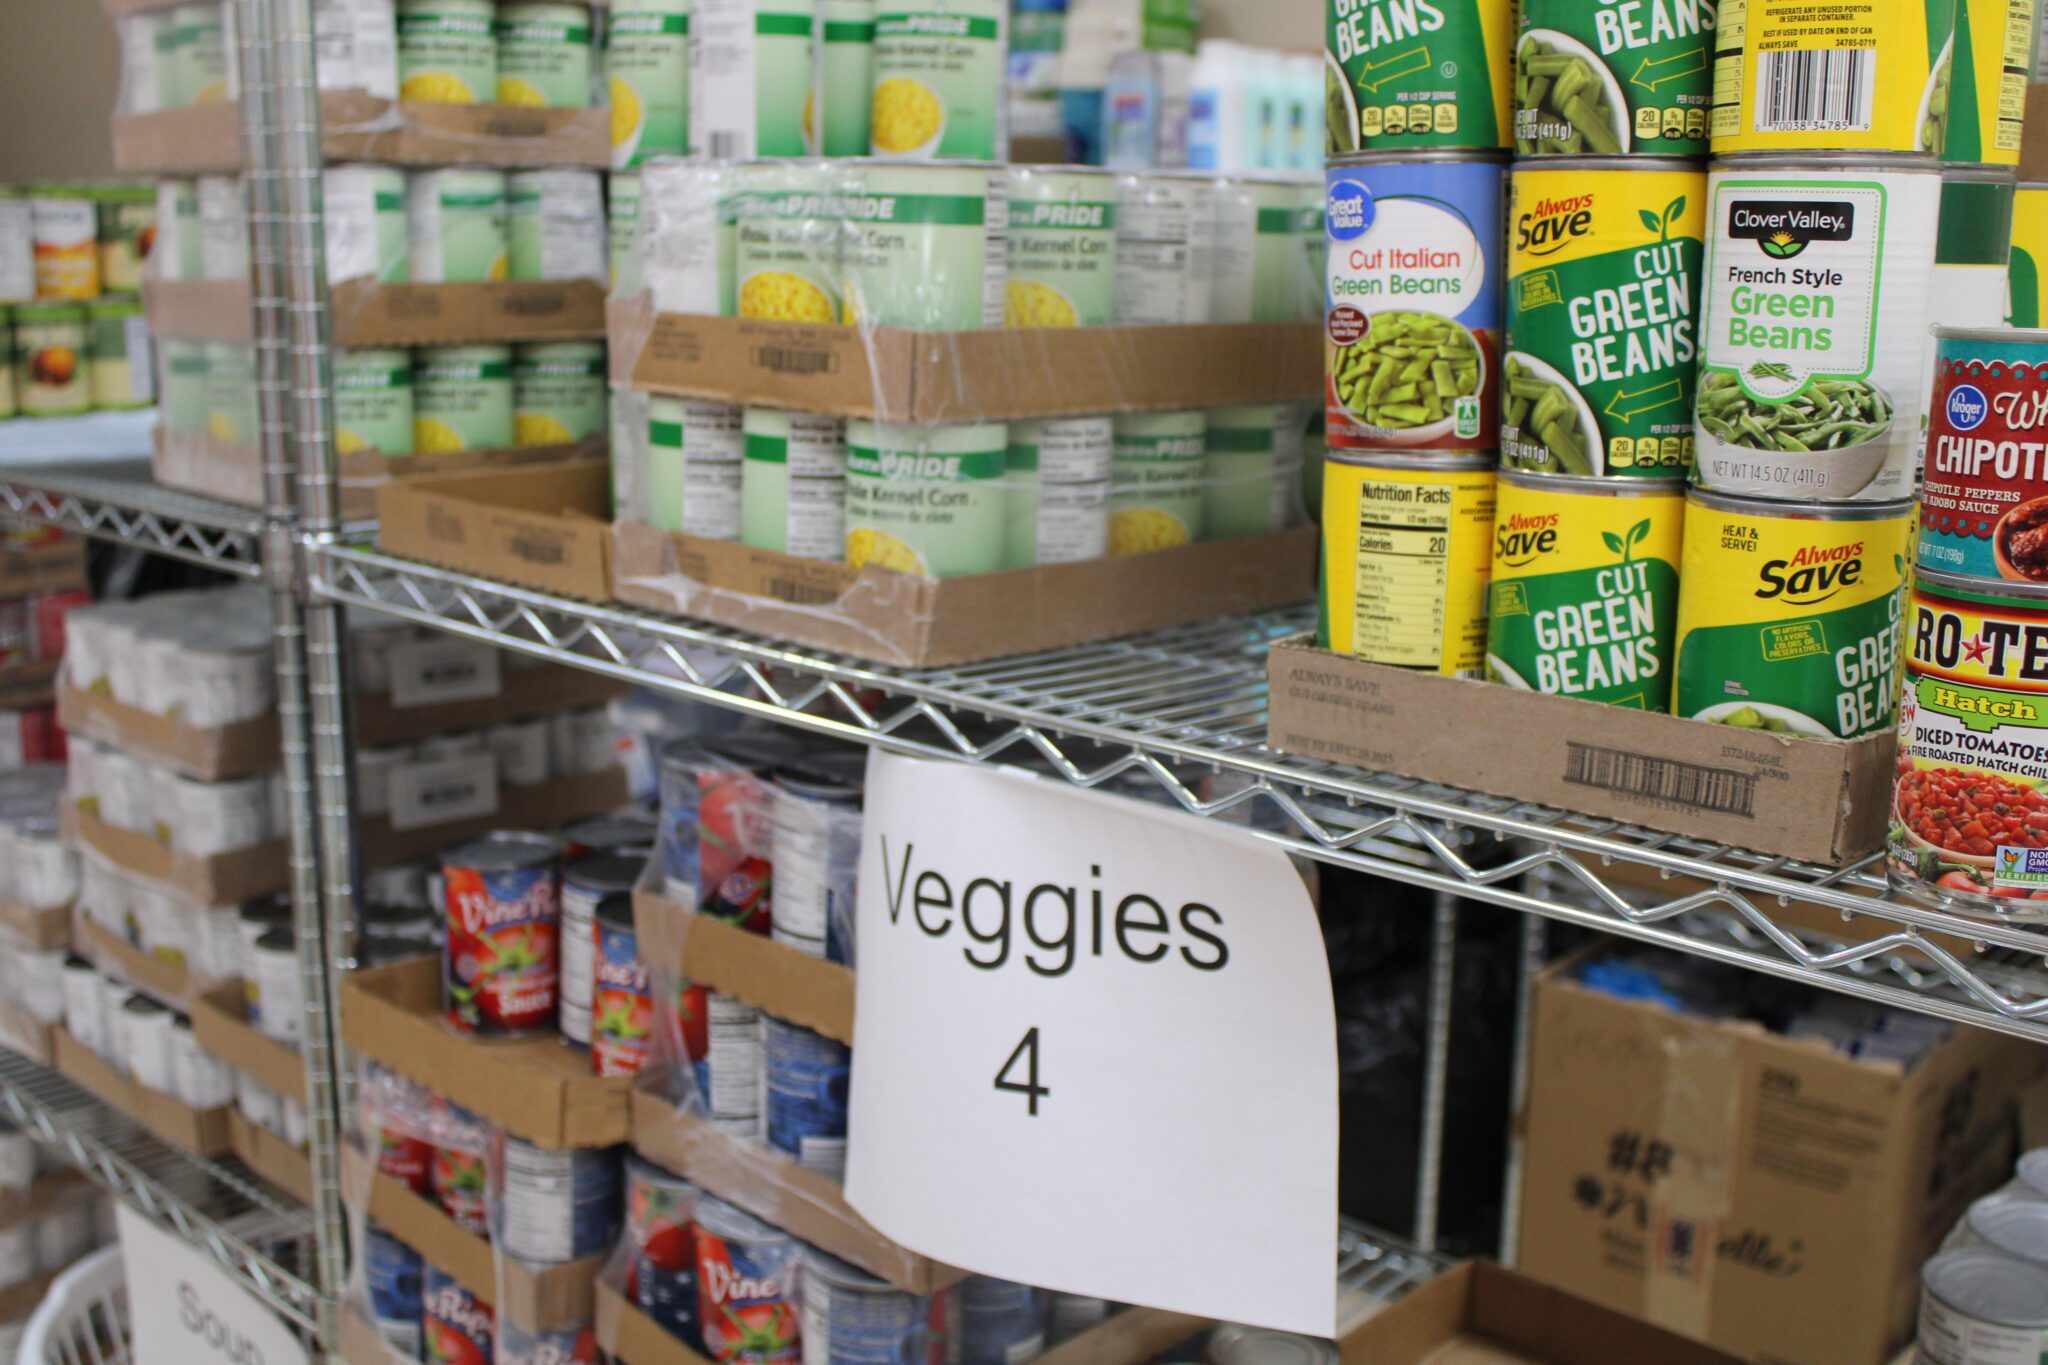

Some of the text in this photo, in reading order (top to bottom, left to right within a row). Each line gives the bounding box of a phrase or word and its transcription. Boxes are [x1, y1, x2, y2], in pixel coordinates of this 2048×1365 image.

[1766, 8, 1801, 16] REFRIGERATE
[1817, 6, 1843, 14] UNUSED
[1336, 0, 1445, 63] BEANS
[1595, 0, 1716, 55] BEANS
[1763, 30, 1776, 38] BEST
[1758, 40, 1799, 50] ALWAYS SAVE
[1835, 38, 1877, 47] 34785-0719
[1367, 110, 1378, 120] 20
[1642, 111, 1655, 122] 20
[1773, 121, 1808, 131] 70038
[1812, 121, 1849, 131] 34785
[1863, 123, 1869, 131] 9
[1538, 122, 1572, 141] (411g)
[1033, 205, 1104, 226] PRIDE
[1329, 195, 1363, 217] Great
[1533, 193, 1594, 220] Always
[1333, 214, 1363, 229] Value
[1516, 210, 1591, 252] Save
[1734, 209, 1844, 232] Clover Valley
[867, 231, 904, 248] Corn
[1021, 236, 1076, 253] Kernel
[1349, 248, 1461, 270] Cut Italian
[1634, 240, 1684, 279] CUT
[1332, 274, 1462, 296] Green Beans
[1728, 266, 1843, 289] French Style
[1569, 272, 1690, 339] GREEN
[1730, 285, 1834, 318] Green
[1728, 317, 1832, 351] Beans
[1571, 320, 1695, 386] BEANS
[1951, 392, 1982, 423] Kroger
[1519, 443, 1549, 464] (411g)
[1616, 440, 1629, 451] 20
[881, 450, 961, 479] PRIDE
[1712, 461, 1831, 488] NET WT 14.5 OZ (411 g)
[872, 485, 925, 504] Kernel
[928, 488, 969, 507] Corn
[1362, 482, 1451, 504] Nutrition Facts
[1924, 480, 2022, 503] CHIPOTLE PEPPERS
[1929, 495, 2000, 515] ADOBO SAUCE
[1361, 511, 1380, 522] Serving
[1407, 515, 1416, 523] 1/2
[1417, 516, 1427, 525] cup
[1508, 513, 1560, 532] Always
[1359, 536, 1393, 551] Calories
[1495, 524, 1557, 560] Save
[1723, 525, 1759, 540] HEAT &
[1429, 537, 1446, 554] 20
[1721, 537, 1757, 552] SERVE!
[1789, 541, 1864, 568] Always
[1936, 546, 1945, 559] OZ
[1944, 547, 1965, 565] (198g)
[1596, 562, 1649, 598] CUT
[1754, 558, 1862, 599] Save
[1534, 591, 1655, 651] GREEN
[1782, 624, 1813, 634] ARTIFICIAL
[1769, 643, 1822, 658] PRESERVATIVES
[1804, 637, 1815, 646] OR
[1535, 636, 1660, 695] BEANS
[1289, 669, 1381, 697] ALWAYS SAVE
[1934, 687, 2038, 720] Hatch
[1916, 726, 1953, 746] DICED
[1912, 747, 1928, 758] FIRE
[1928, 748, 1975, 766] ROASTED
[1976, 755, 2019, 774] HATCH
[458, 892, 530, 935] Vine
[880, 833, 1231, 978] Veggies
[993, 1026, 1050, 1117] 4
[703, 1258, 781, 1305] Vine
